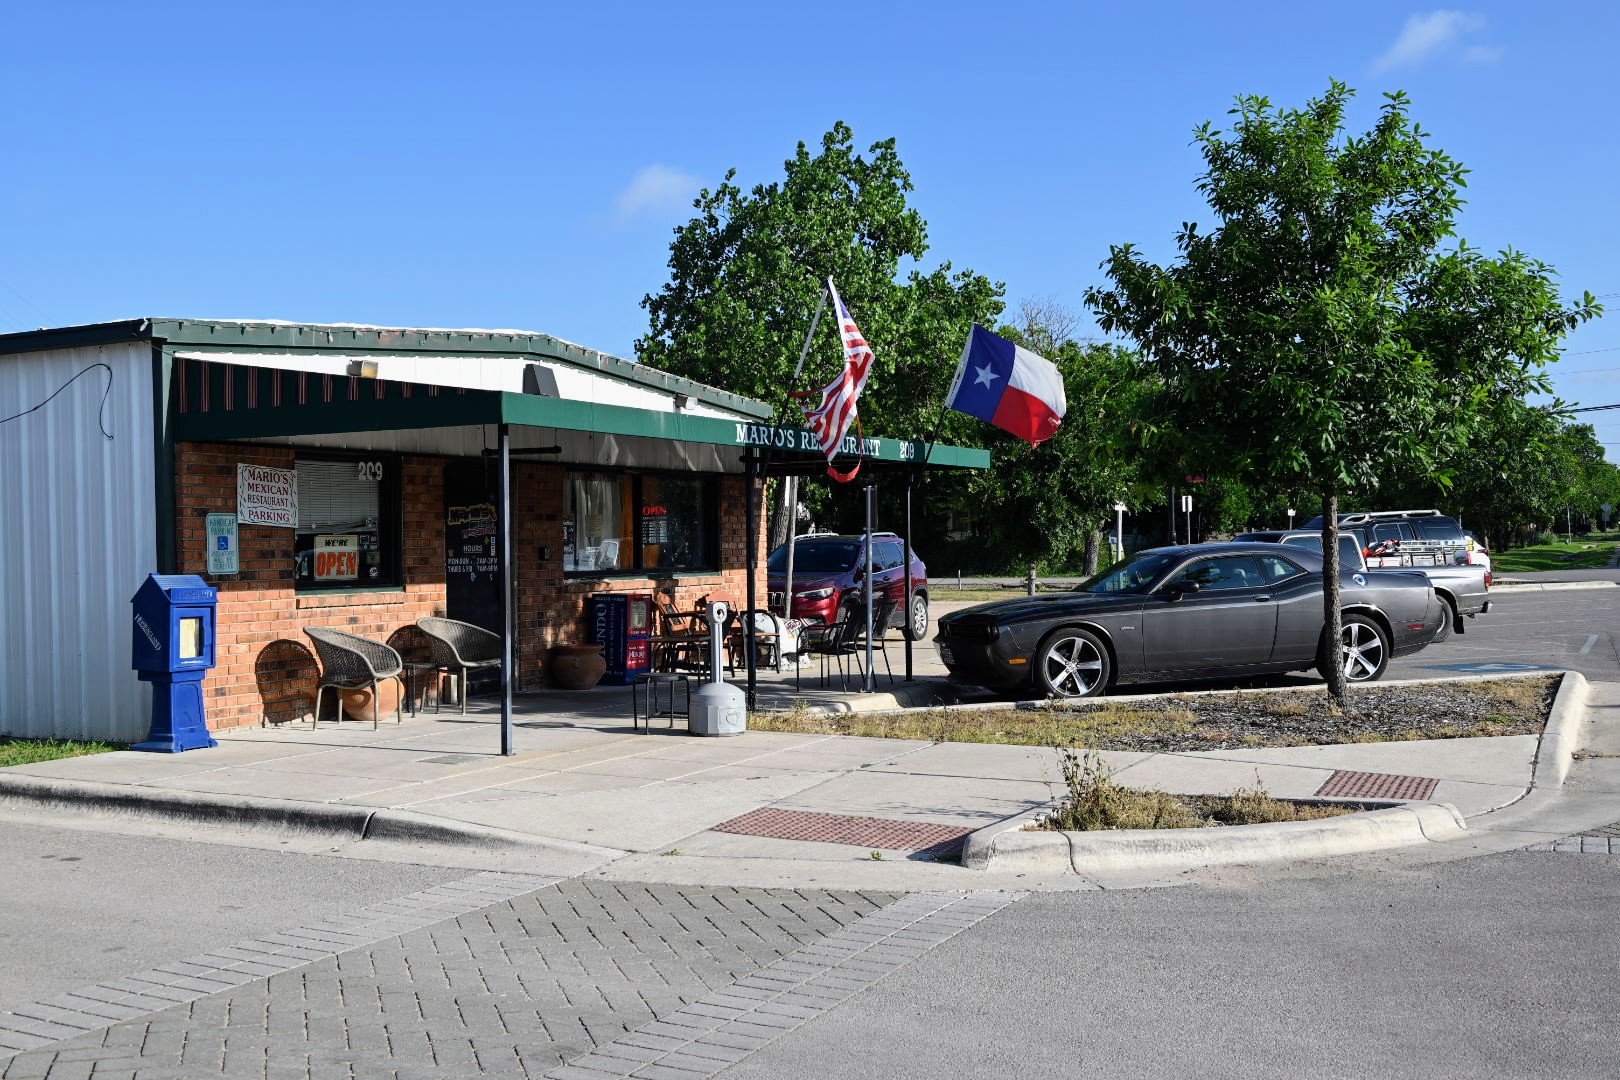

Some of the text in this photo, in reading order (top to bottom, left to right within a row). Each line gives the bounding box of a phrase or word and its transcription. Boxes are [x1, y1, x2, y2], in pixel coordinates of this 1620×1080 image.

[736, 424, 881, 456] MARIO'S REURANT
[900, 441, 914, 459] 209
[247, 469, 289, 485] MARIO'S
[358, 461, 383, 481] 209
[247, 483, 289, 496] MEXICAN
[247, 494, 289, 507] RESTAURANT
[248, 509, 290, 522] PARKING
[642, 505, 668, 516] OPEN
[209, 518, 235, 526] HANDICAP
[210, 527, 234, 536] PARKING
[325, 539, 349, 547] WE'RE
[316, 551, 357, 577] OPEN
[596, 603, 607, 656] UNDO
